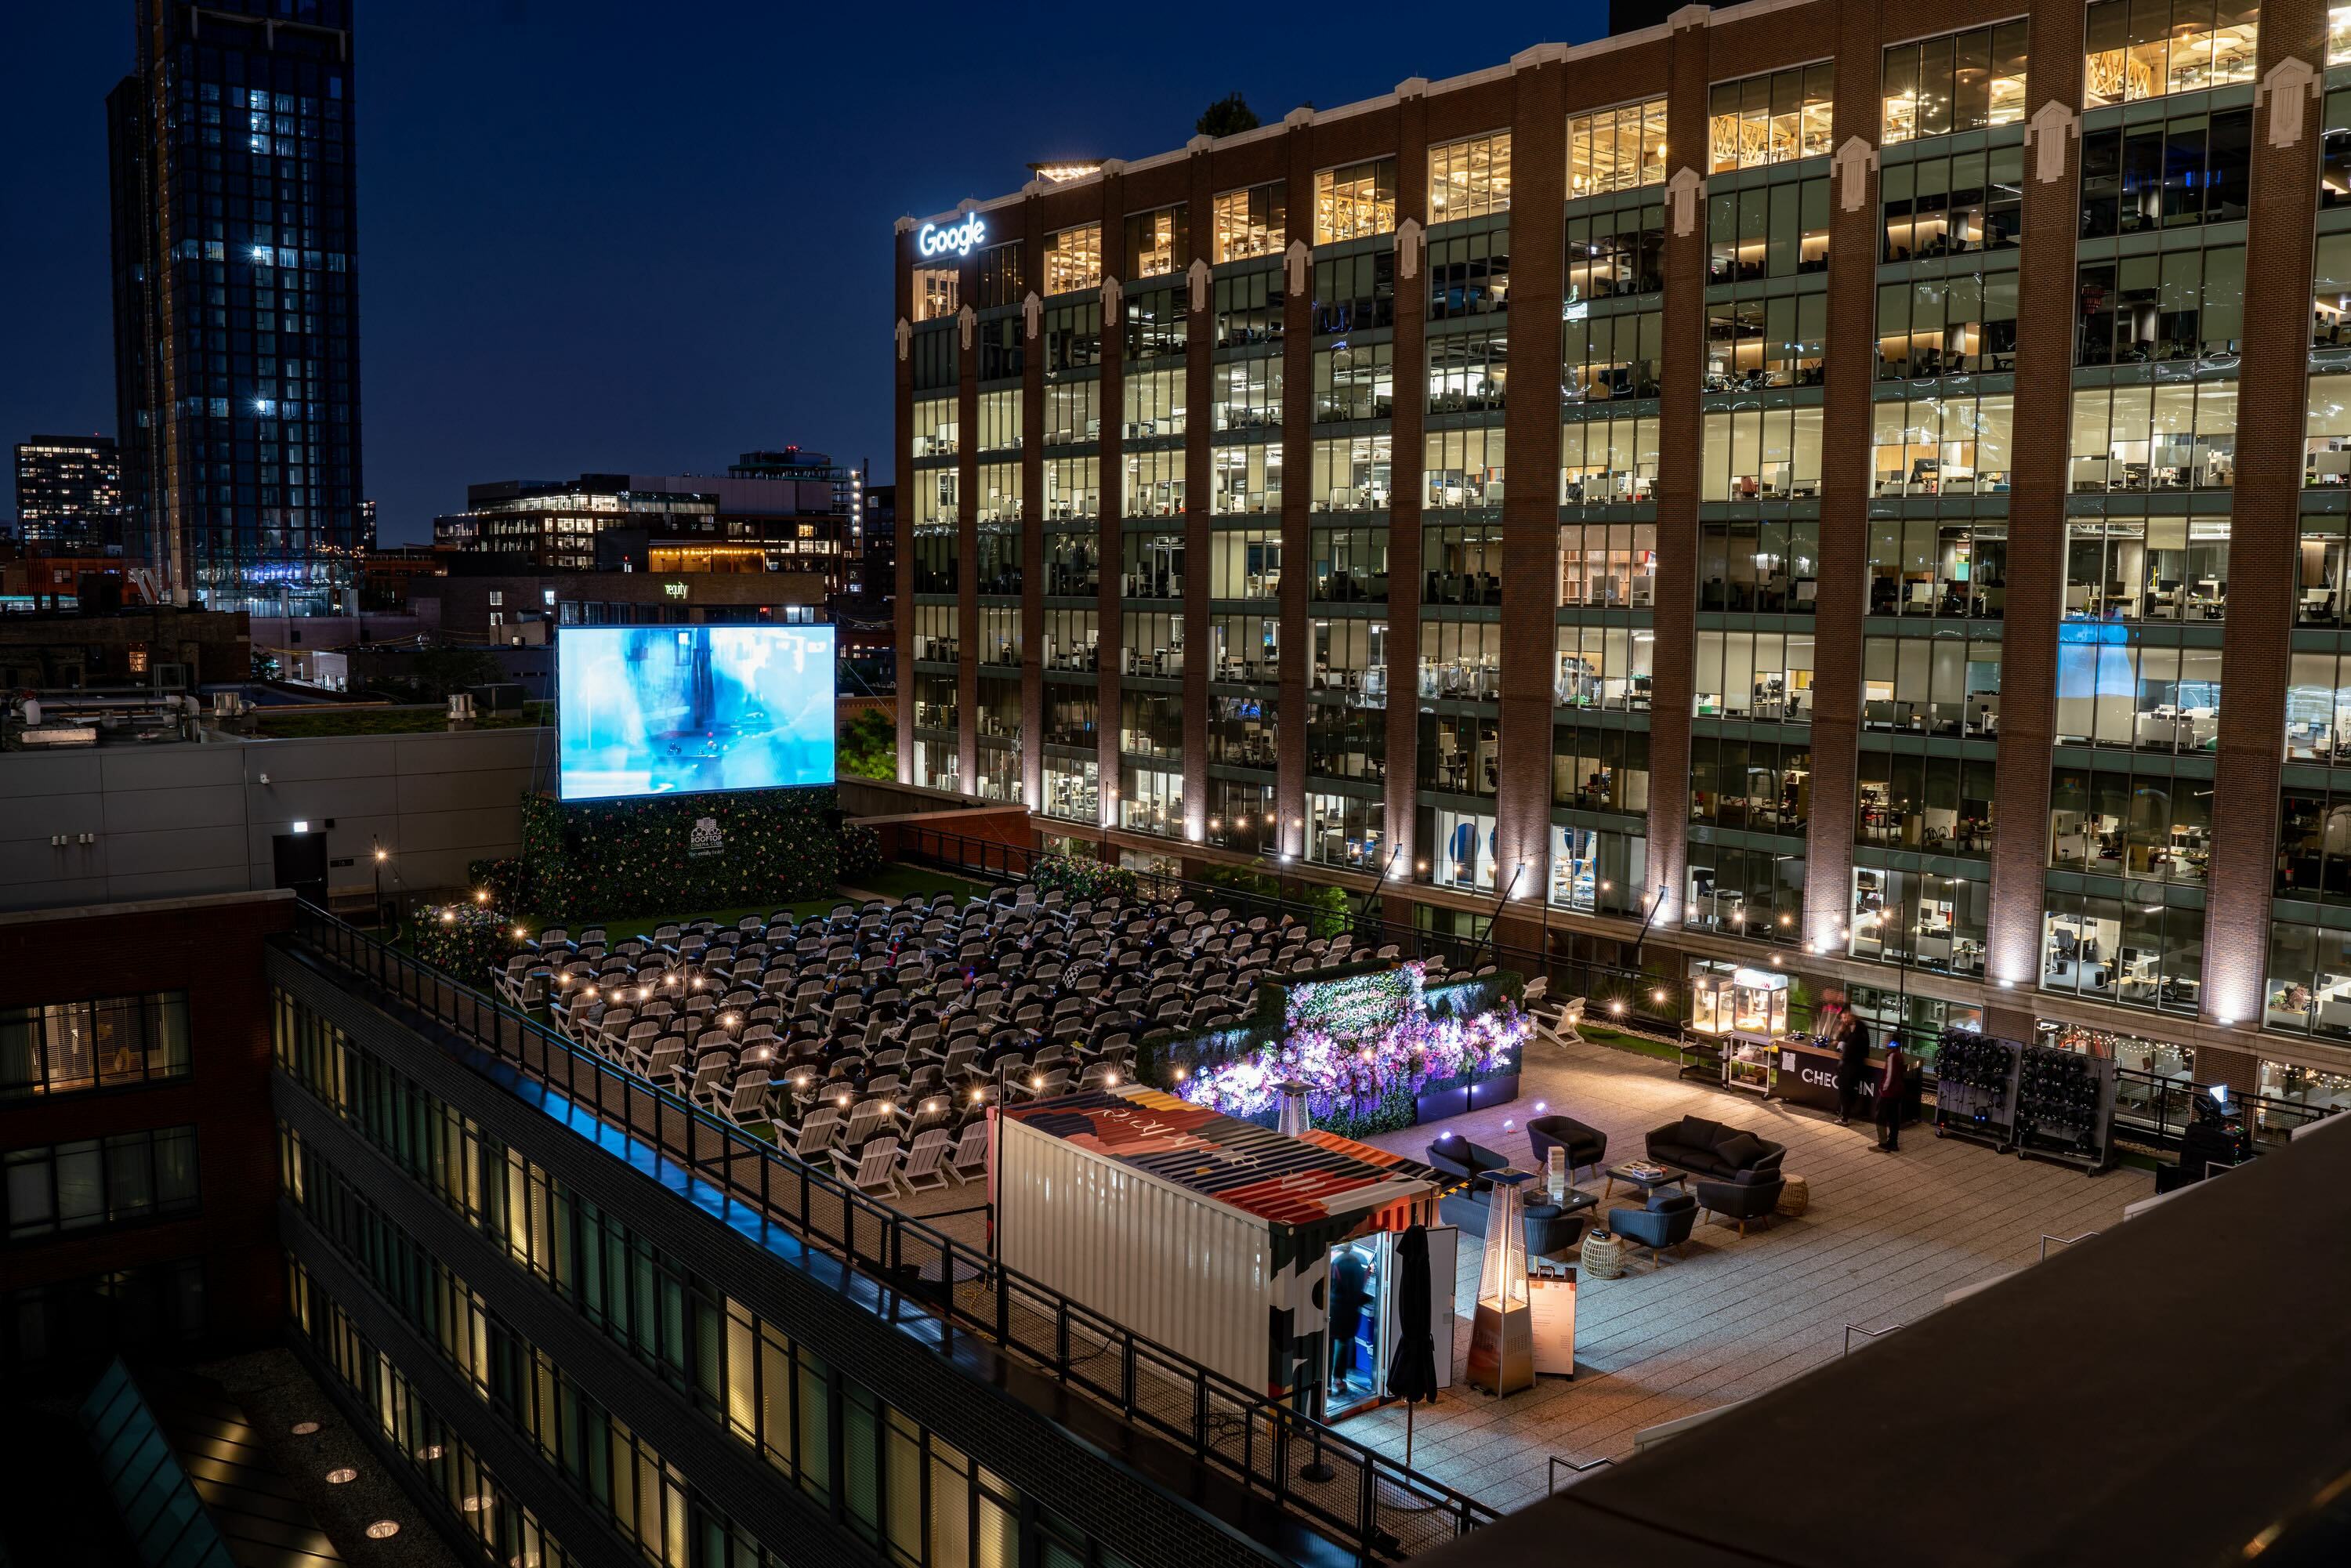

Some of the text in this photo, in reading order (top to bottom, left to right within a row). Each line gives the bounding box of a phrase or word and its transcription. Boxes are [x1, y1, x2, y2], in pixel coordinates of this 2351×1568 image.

[919, 212, 985, 256] Google
[690, 835, 723, 844] ROOFTOP
[1801, 1068, 1875, 1097] CHEC-IN
